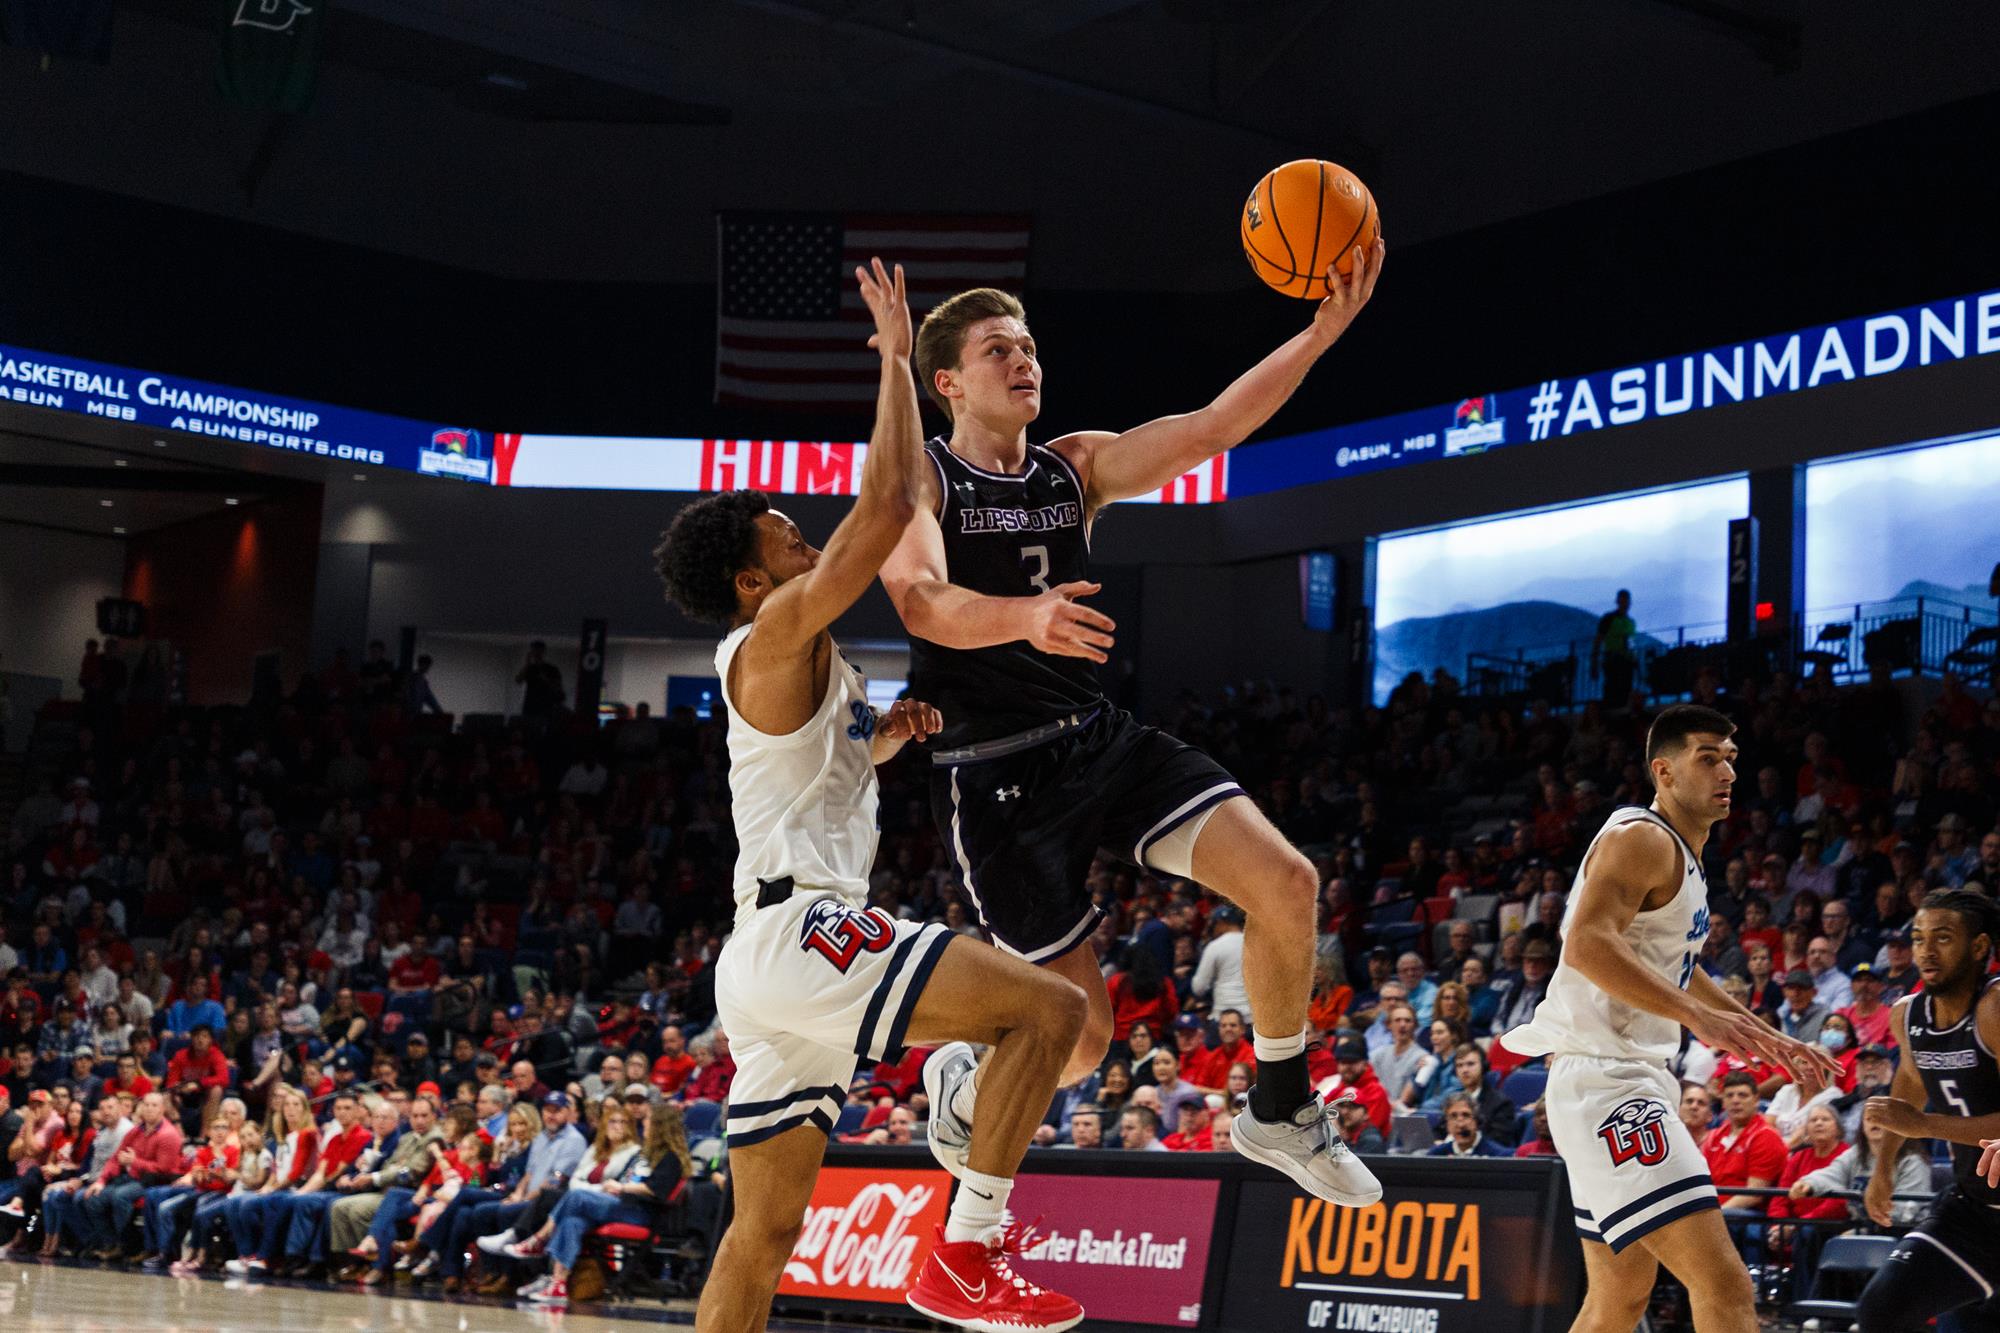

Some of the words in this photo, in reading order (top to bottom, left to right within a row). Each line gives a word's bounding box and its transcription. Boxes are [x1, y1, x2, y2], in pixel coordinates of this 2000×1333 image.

[0, 351, 130, 400] ASKETBALL
[138, 377, 319, 432] CHAMPIONSHIP
[1527, 292, 2000, 441] #ASUNMADNE
[87, 400, 137, 421] MBB
[170, 416, 384, 464] ASUNSPORTS.ORG
[960, 501, 1079, 534] LIPSCOMB
[1020, 545, 1050, 595] 3
[1938, 1080, 1971, 1118] 5
[1597, 1116, 1670, 1168] LU
[1279, 1196, 1481, 1301] KUBOTA
[1307, 1299, 1334, 1328] OF
[1335, 1302, 1439, 1333] LYNCHBURG
